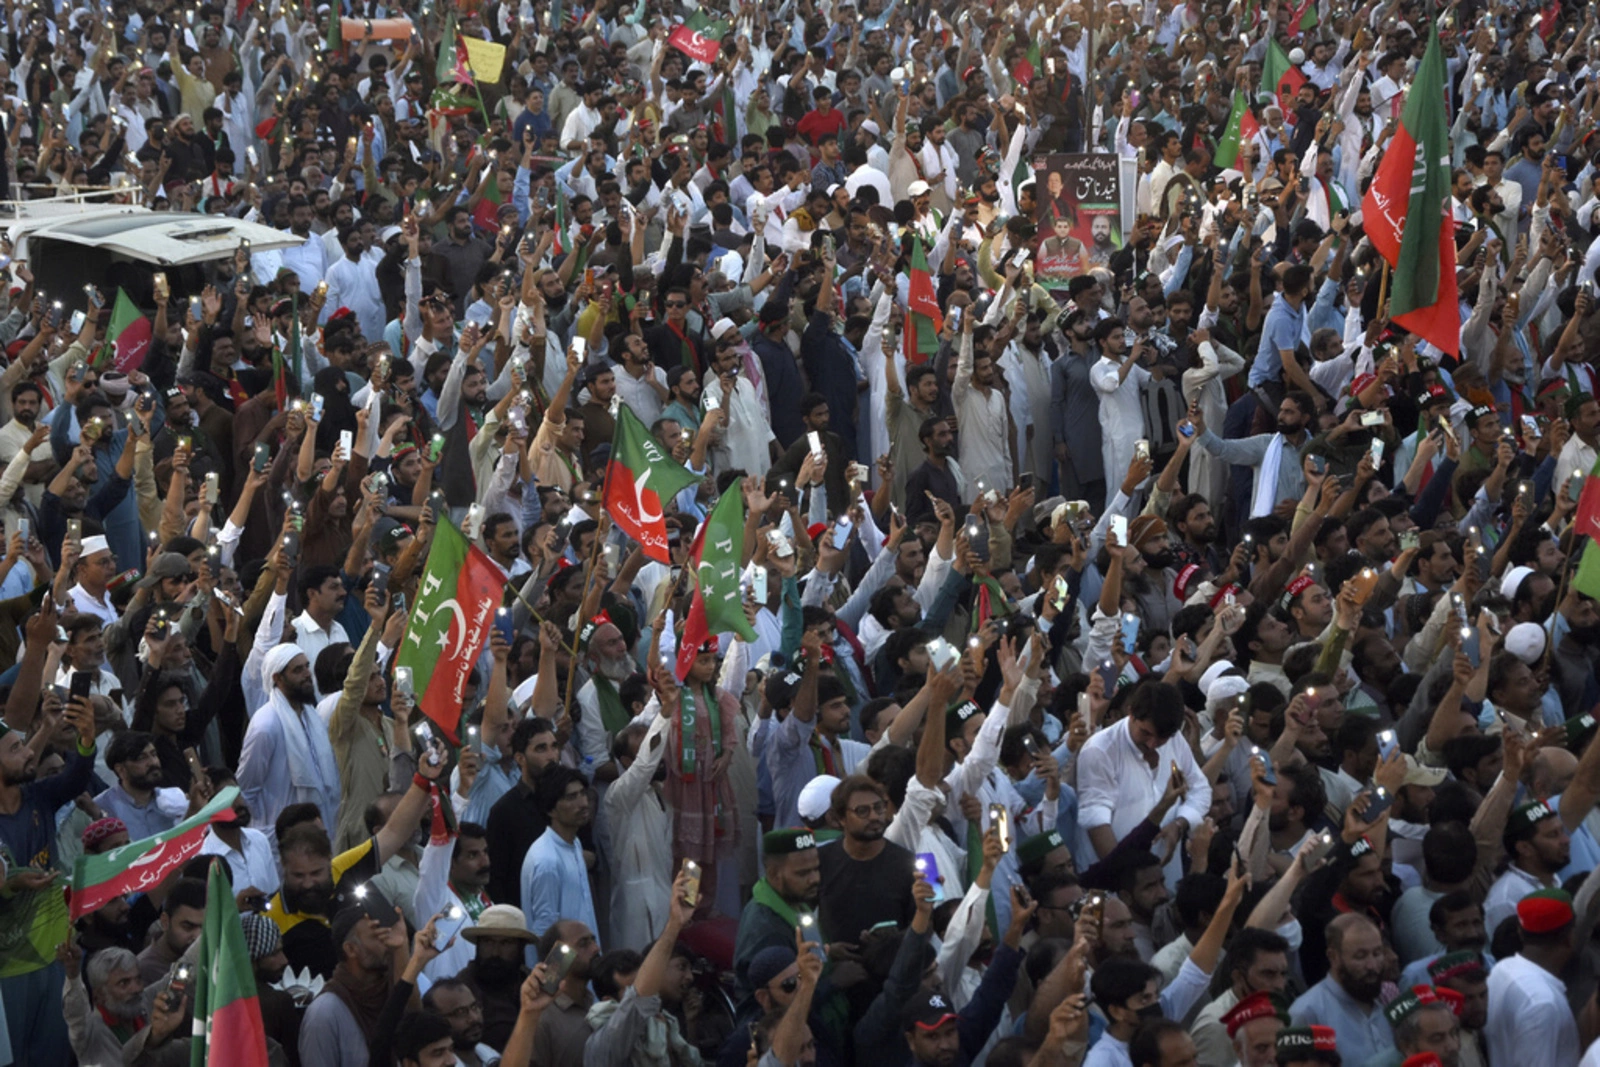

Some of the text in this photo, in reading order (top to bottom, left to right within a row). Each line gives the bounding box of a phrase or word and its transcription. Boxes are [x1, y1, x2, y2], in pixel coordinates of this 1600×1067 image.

[716, 537, 736, 601] PTI
[957, 701, 978, 720] 804
[1526, 803, 1549, 821] 804
[795, 833, 815, 849] 804
[1350, 838, 1370, 857] 804
